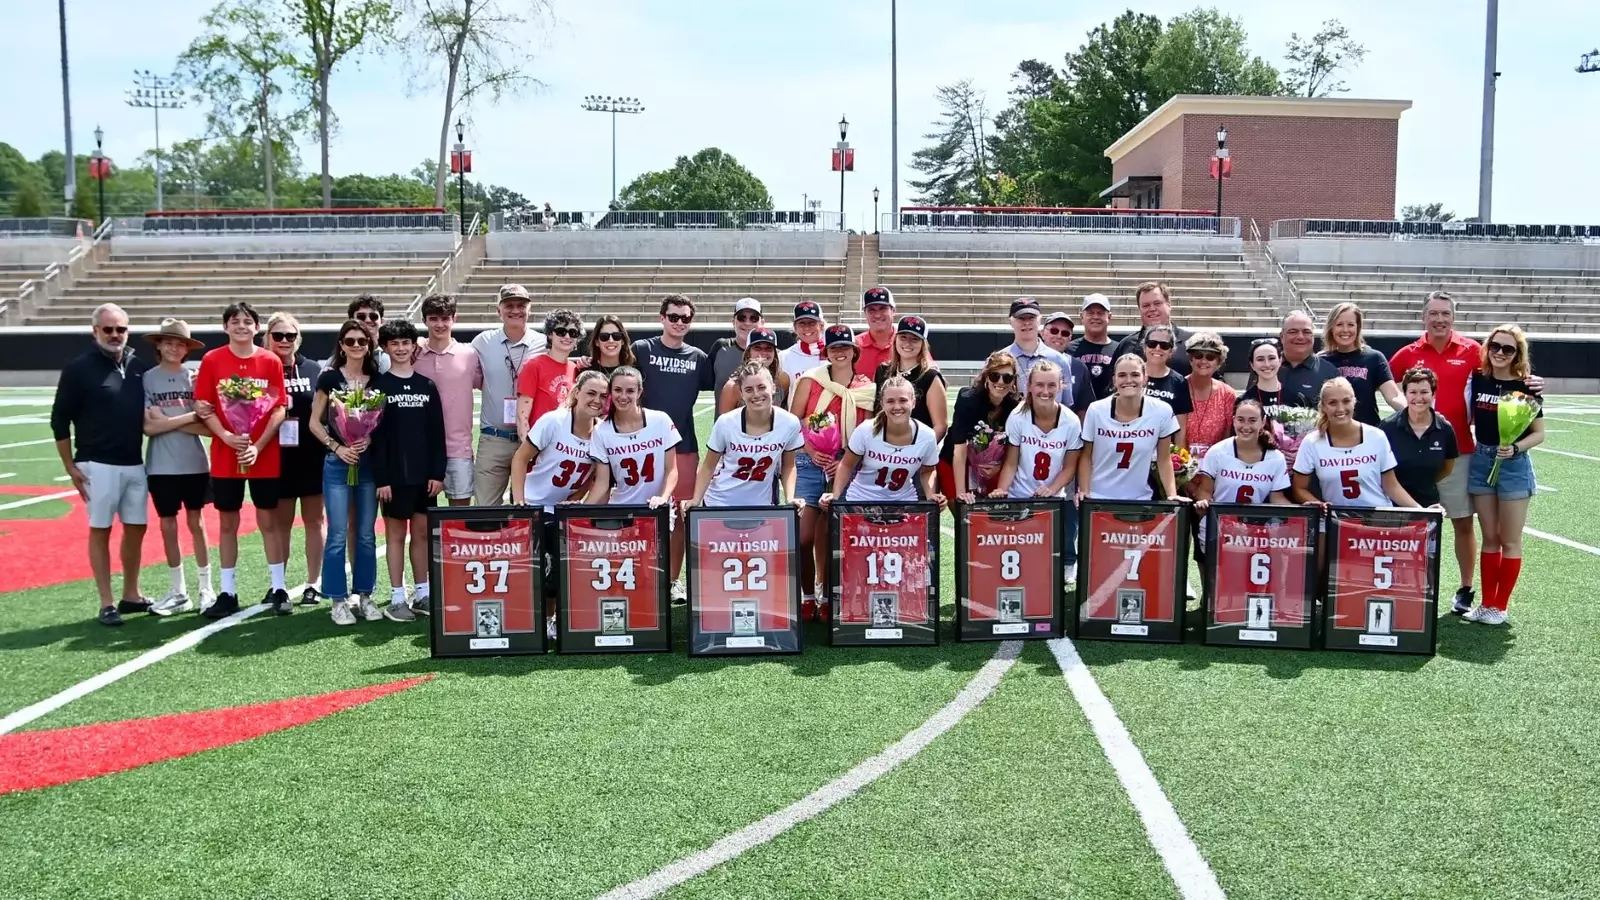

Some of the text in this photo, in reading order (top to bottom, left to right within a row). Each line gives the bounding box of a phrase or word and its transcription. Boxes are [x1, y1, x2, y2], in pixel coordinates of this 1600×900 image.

[649, 354, 697, 371] DAVIDSON
[388, 394, 430, 404] DAVIDSON
[1476, 392, 1499, 404] DAVID
[1021, 435, 1068, 449] DAVIDSON
[1097, 428, 1155, 439] DAVIDSON
[555, 441, 591, 460] DAVIDS
[606, 438, 663, 456] DAVIDSON
[729, 442, 785, 454] DAVIDSON
[1116, 442, 1134, 469] 7
[868, 449, 924, 465] DAVIDSON
[1033, 451, 1051, 481] 8
[1319, 454, 1377, 468] DAVIDSON
[552, 459, 592, 490] 37
[619, 452, 655, 487] 34
[731, 455, 773, 482] 22
[1220, 468, 1275, 483] DAVIDSON
[874, 466, 909, 492] 19
[1340, 469, 1361, 500] 5
[1236, 485, 1254, 503] 6
[578, 540, 648, 553] DAVIDSON
[709, 540, 780, 554] DAVIDSON
[849, 535, 919, 548] DAVIDSON
[976, 533, 1044, 547] DAVIDSON
[1101, 532, 1166, 546] DAVIDSON
[1223, 534, 1299, 549] DAVIDSON
[1348, 538, 1420, 552] DAVIDSON
[450, 543, 522, 557] DAVIDSON
[866, 551, 903, 585] 19
[1001, 550, 1020, 580] 8
[1124, 549, 1142, 580] 7
[1250, 553, 1271, 585] 6
[1373, 556, 1394, 590] 5
[465, 560, 510, 594] 37
[591, 557, 636, 591] 34
[723, 557, 768, 591] 22
